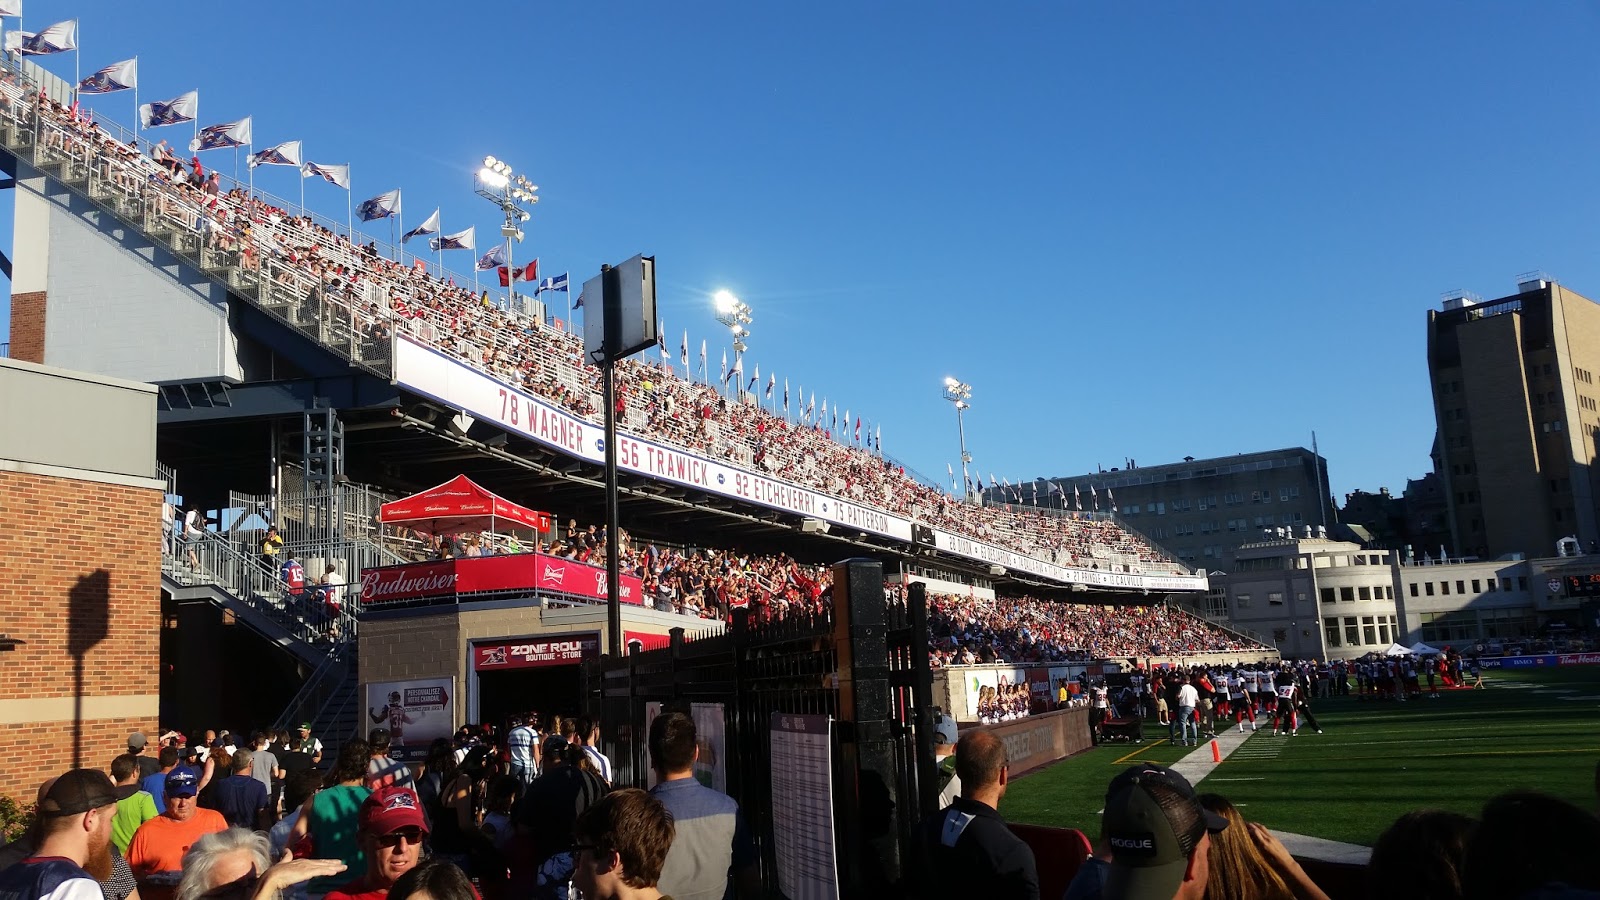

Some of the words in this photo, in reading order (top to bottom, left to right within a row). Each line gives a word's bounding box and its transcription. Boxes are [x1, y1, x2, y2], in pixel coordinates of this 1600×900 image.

[499, 388, 519, 426] 78
[527, 401, 583, 453] WAGNER
[621, 438, 639, 468] 56
[647, 446, 708, 487] TRAWICK
[735, 473, 749, 497] 92
[754, 478, 816, 515] ETCHEVERRY
[833, 501, 844, 521] 75
[847, 503, 889, 533] PATTERSON
[291, 568, 304, 582] 15
[361, 569, 459, 598] Budweiser
[1115, 575, 1144, 587] CALVILLO
[510, 643, 548, 656] ZONE
[525, 652, 556, 662] BOUTIQUE
[562, 650, 582, 659] STORE
[1111, 837, 1152, 849] ROGUE
